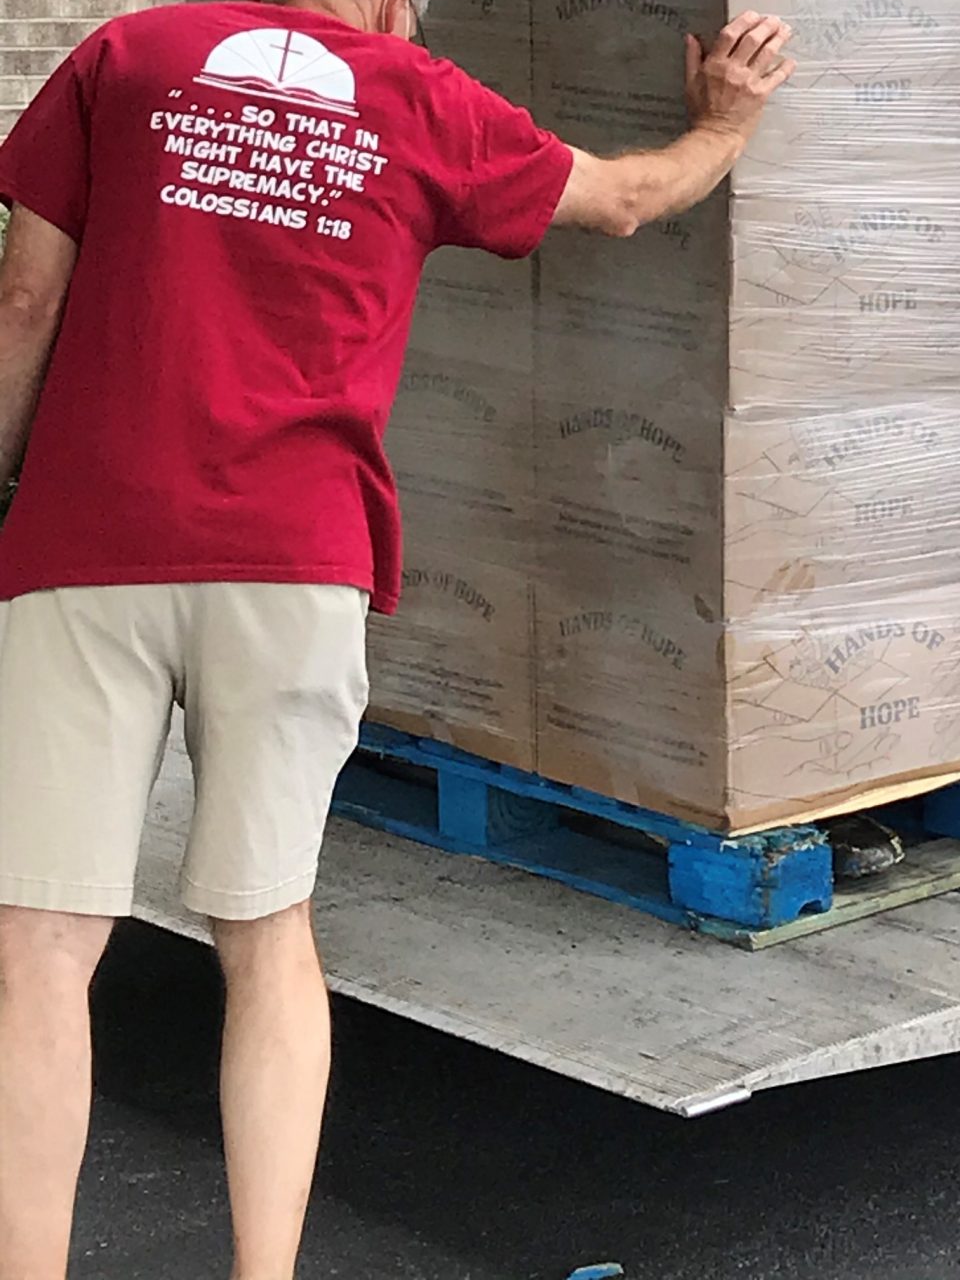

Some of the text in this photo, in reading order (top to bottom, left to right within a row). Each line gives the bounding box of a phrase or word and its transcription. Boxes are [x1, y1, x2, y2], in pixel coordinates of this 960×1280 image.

[150, 110, 388, 175] EVERYTHING CHRIST
[241, 105, 276, 127] SO
[286, 112, 347, 140] THAT
[355, 129, 379, 151] IN
[164, 134, 364, 192] MIGHT HAVE THE
[160, 184, 352, 240] COLOSSIANS 1:18
[858, 288, 918, 314] HOPE
[640, 418, 686, 464] HOPE
[402, 569, 430, 587] NDS
[454, 579, 496, 623] HOPE
[559, 611, 613, 637] HANDS
[824, 621, 946, 675] HANDS OF
[859, 696, 921, 730] HOPE
